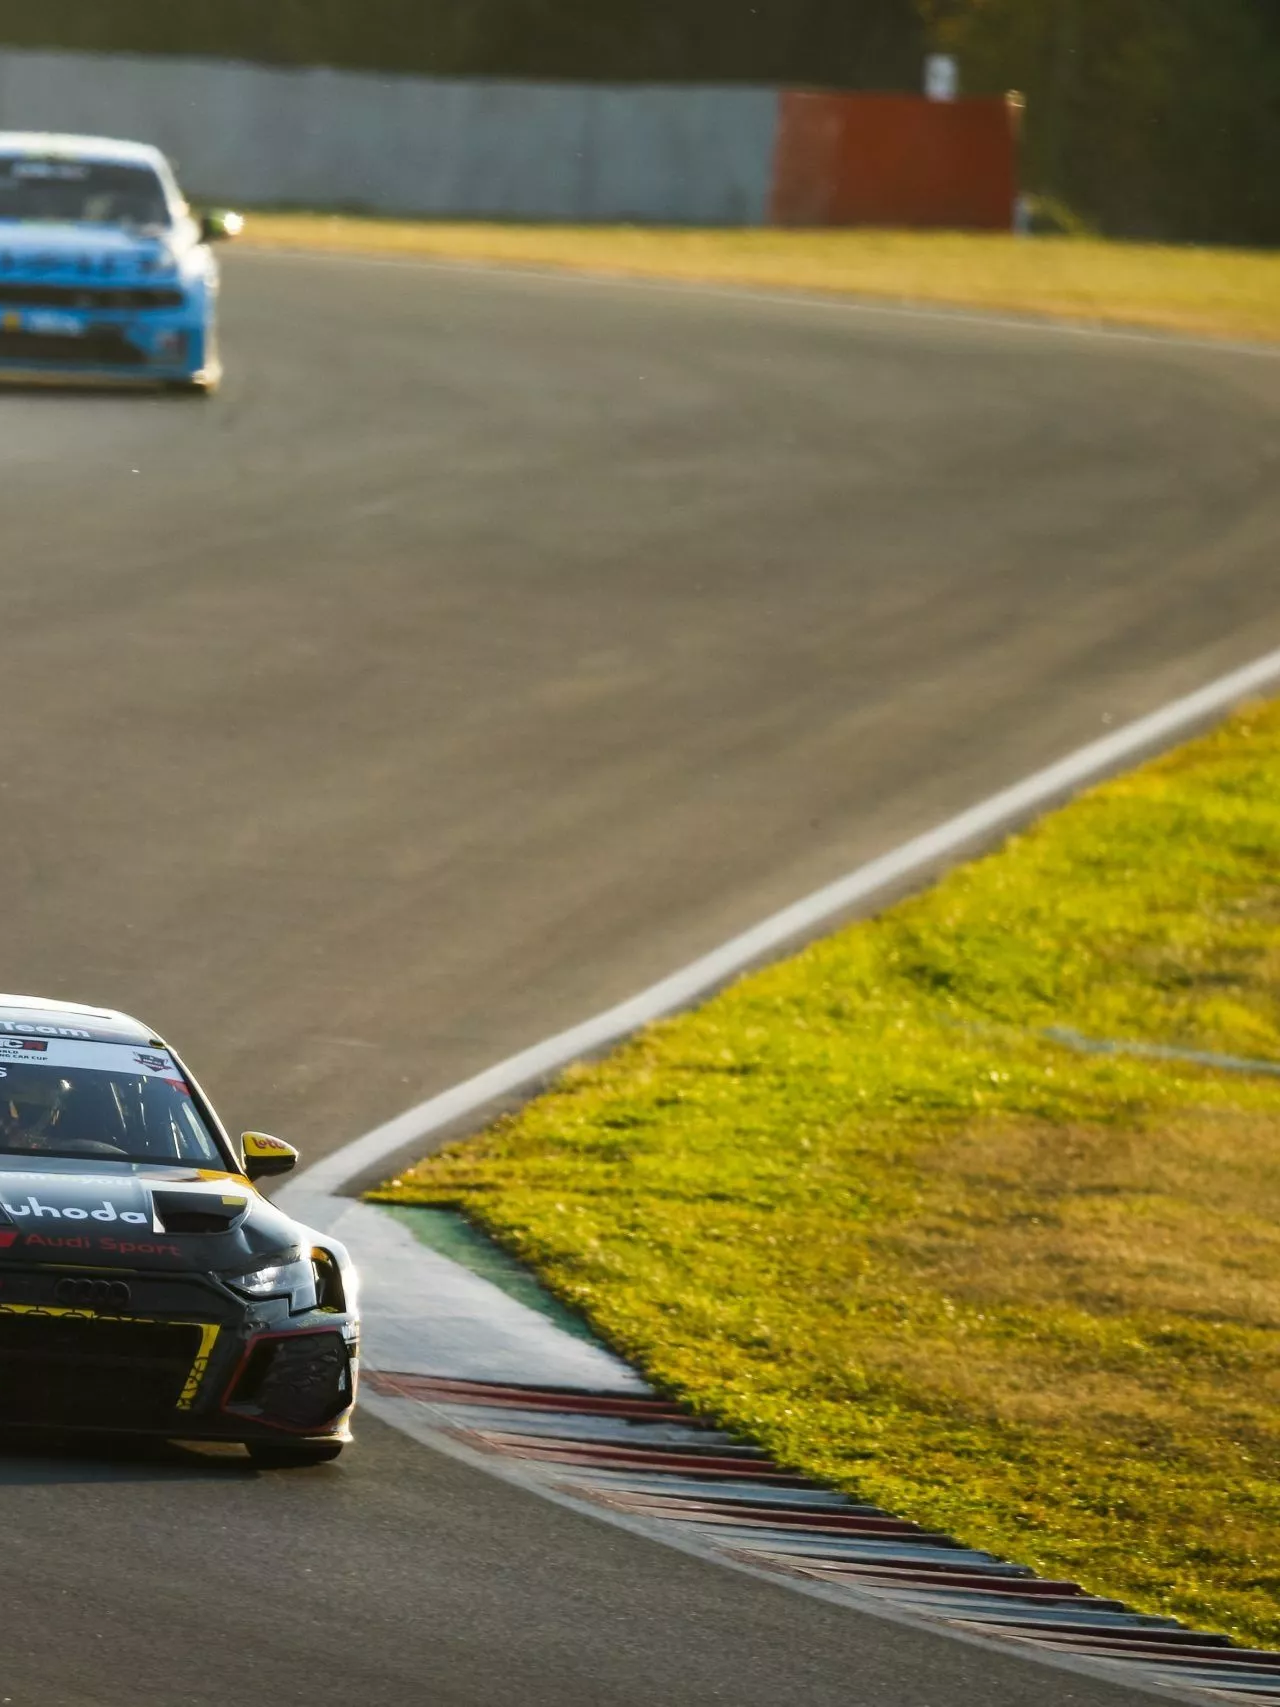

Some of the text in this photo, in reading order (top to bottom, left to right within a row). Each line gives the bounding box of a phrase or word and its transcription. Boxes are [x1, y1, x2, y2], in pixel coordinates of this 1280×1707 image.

[3, 1196, 148, 1224] uhoda
[25, 1233, 182, 1256] Audi Sport
